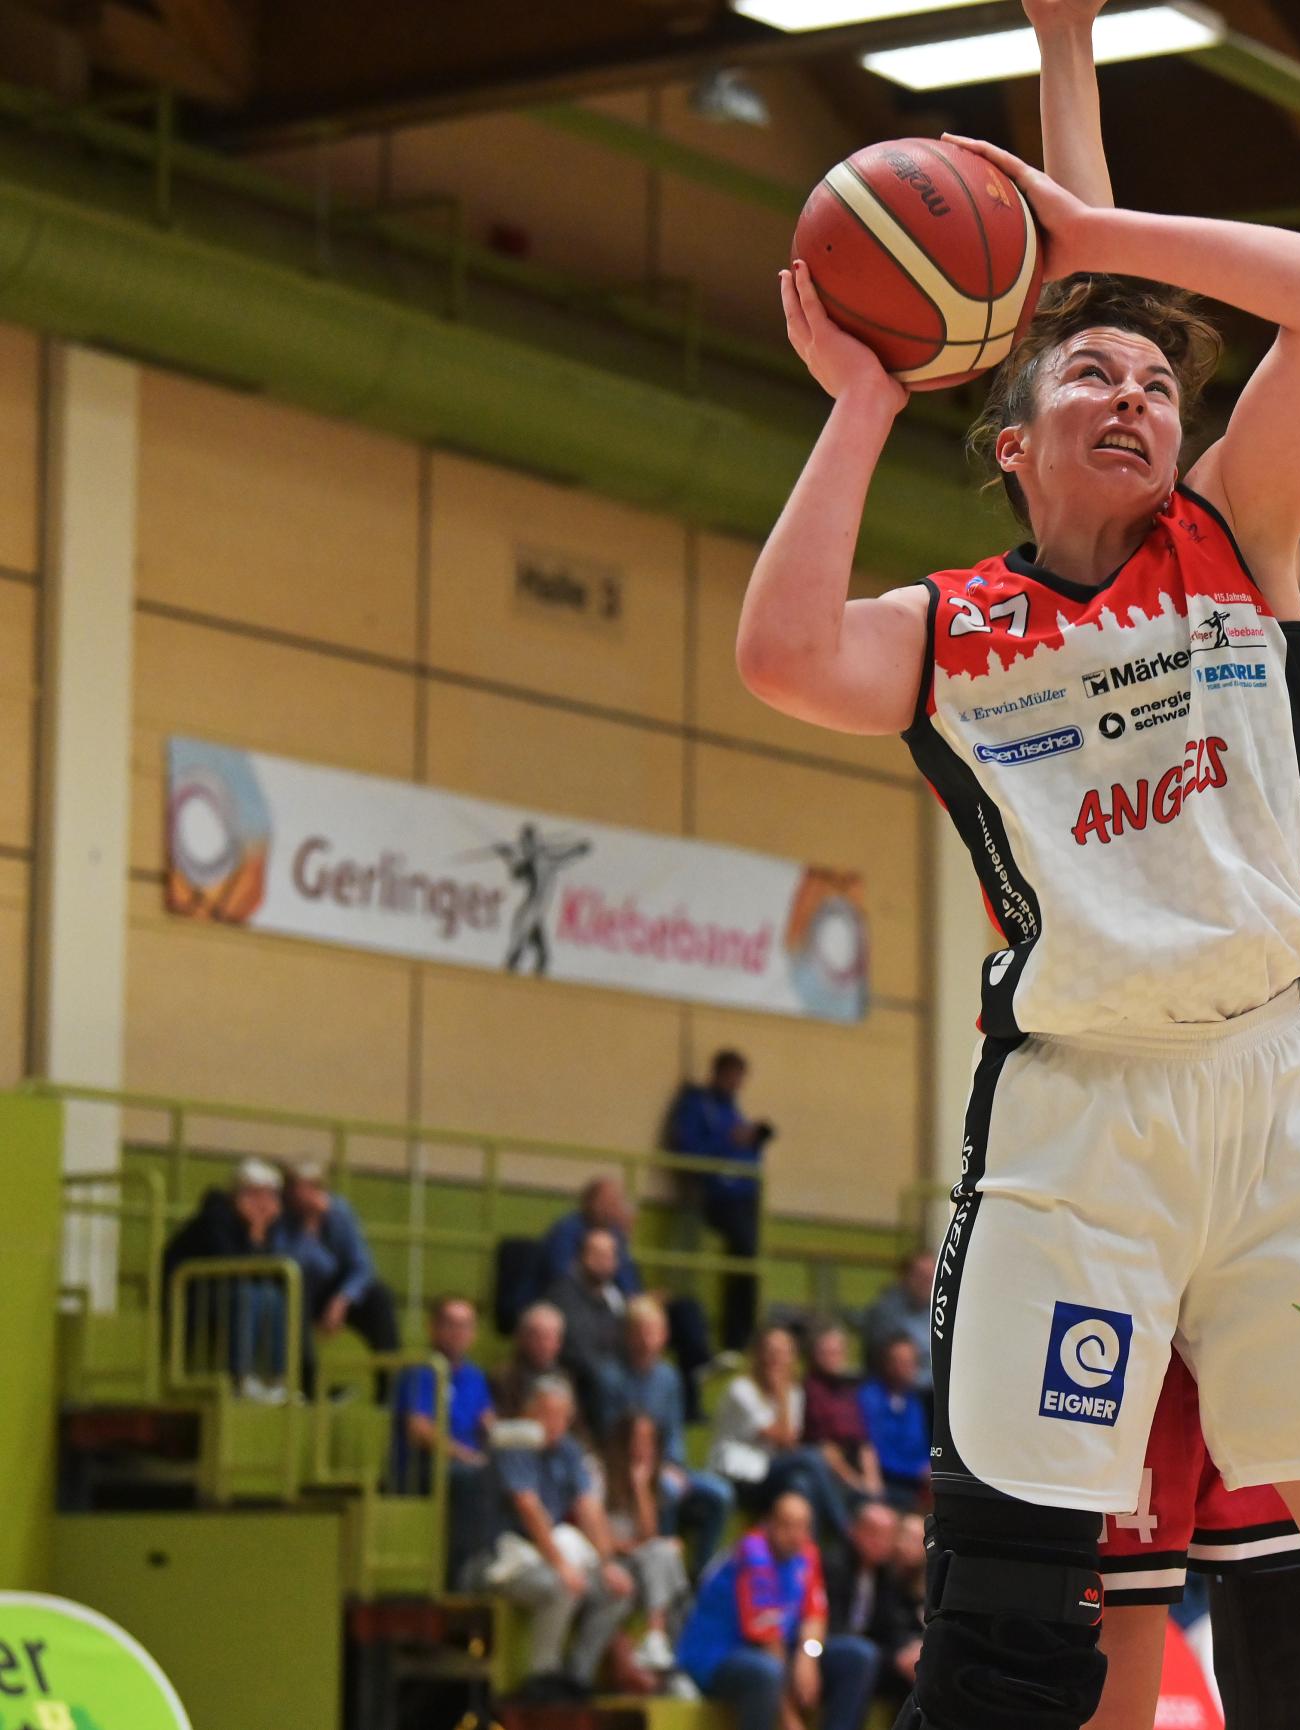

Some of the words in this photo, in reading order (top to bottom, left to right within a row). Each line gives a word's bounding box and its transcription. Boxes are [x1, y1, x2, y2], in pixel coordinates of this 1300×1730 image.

[947, 591, 1031, 638] 27
[973, 702, 1018, 721] Erwin
[1018, 687, 1067, 709] Müller
[1130, 690, 1191, 718] energie
[1043, 1389, 1117, 1420] EIGNER
